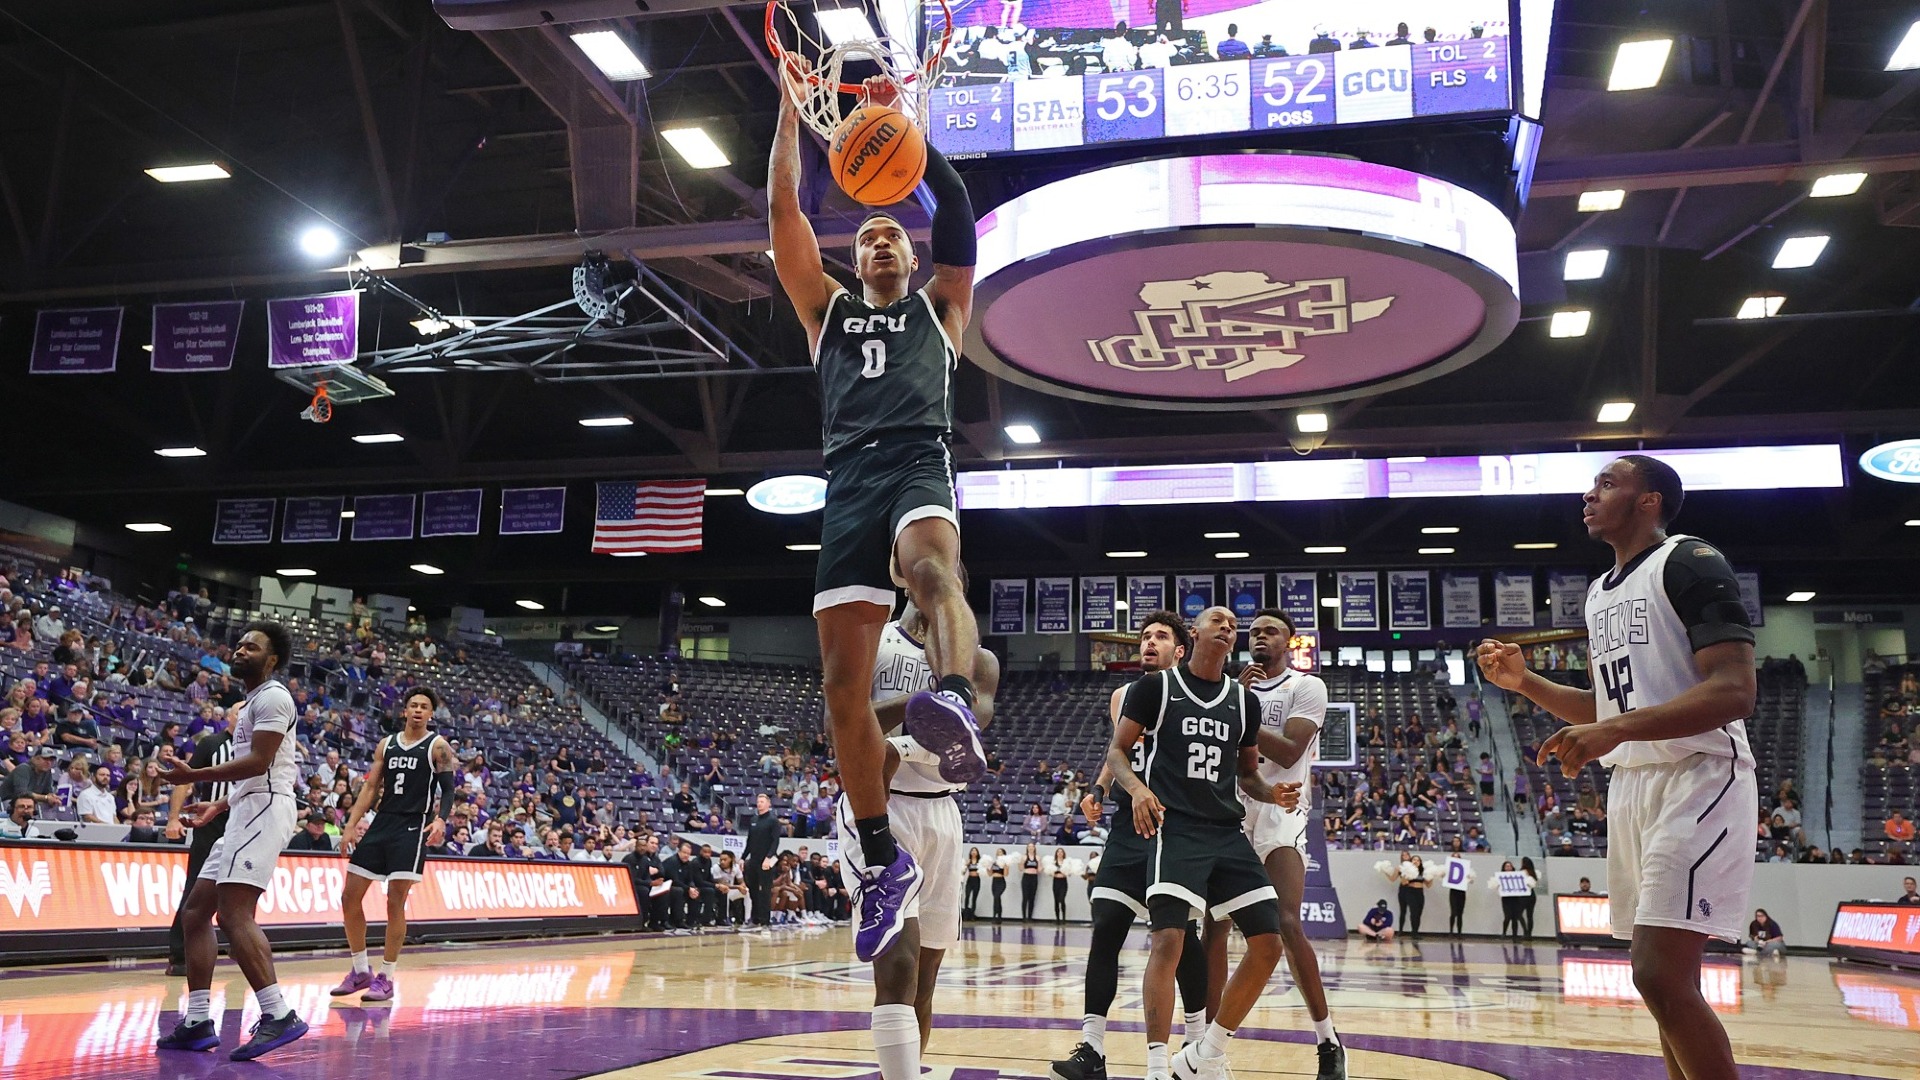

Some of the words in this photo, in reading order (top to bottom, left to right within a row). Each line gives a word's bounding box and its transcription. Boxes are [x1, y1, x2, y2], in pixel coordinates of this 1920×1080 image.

[1427, 45, 1467, 62] TOL
[1483, 41, 1496, 58] 2
[1178, 73, 1238, 100] 6:35
[1262, 59, 1327, 107] 52
[1343, 68, 1408, 96] GCU
[1430, 69, 1467, 87] FLS
[1484, 65, 1498, 82] 4
[945, 89, 979, 106] TOL
[991, 86, 1002, 102] 2
[1096, 75, 1157, 120] 53
[946, 113, 977, 129] FLS
[991, 107, 1002, 123] 4
[1267, 109, 1314, 127] POSS
[848, 122, 898, 176] Wilson
[945, 153, 988, 161] TRONICS
[843, 313, 907, 334] GCU
[861, 340, 886, 378] 0
[1041, 622, 1066, 630] NCAA
[1589, 599, 1649, 660] JACKS
[1843, 612, 1873, 623] Men
[880, 653, 932, 693] JAC
[1599, 655, 1637, 714] 42
[1182, 716, 1230, 742] GCU
[388, 756, 418, 770] GCU
[1187, 742, 1222, 783] 22
[394, 772, 405, 795] 2
[1448, 861, 1465, 884] D
[435, 870, 583, 910] WHATABURGER
[1833, 911, 1898, 942] WHATABURGER
